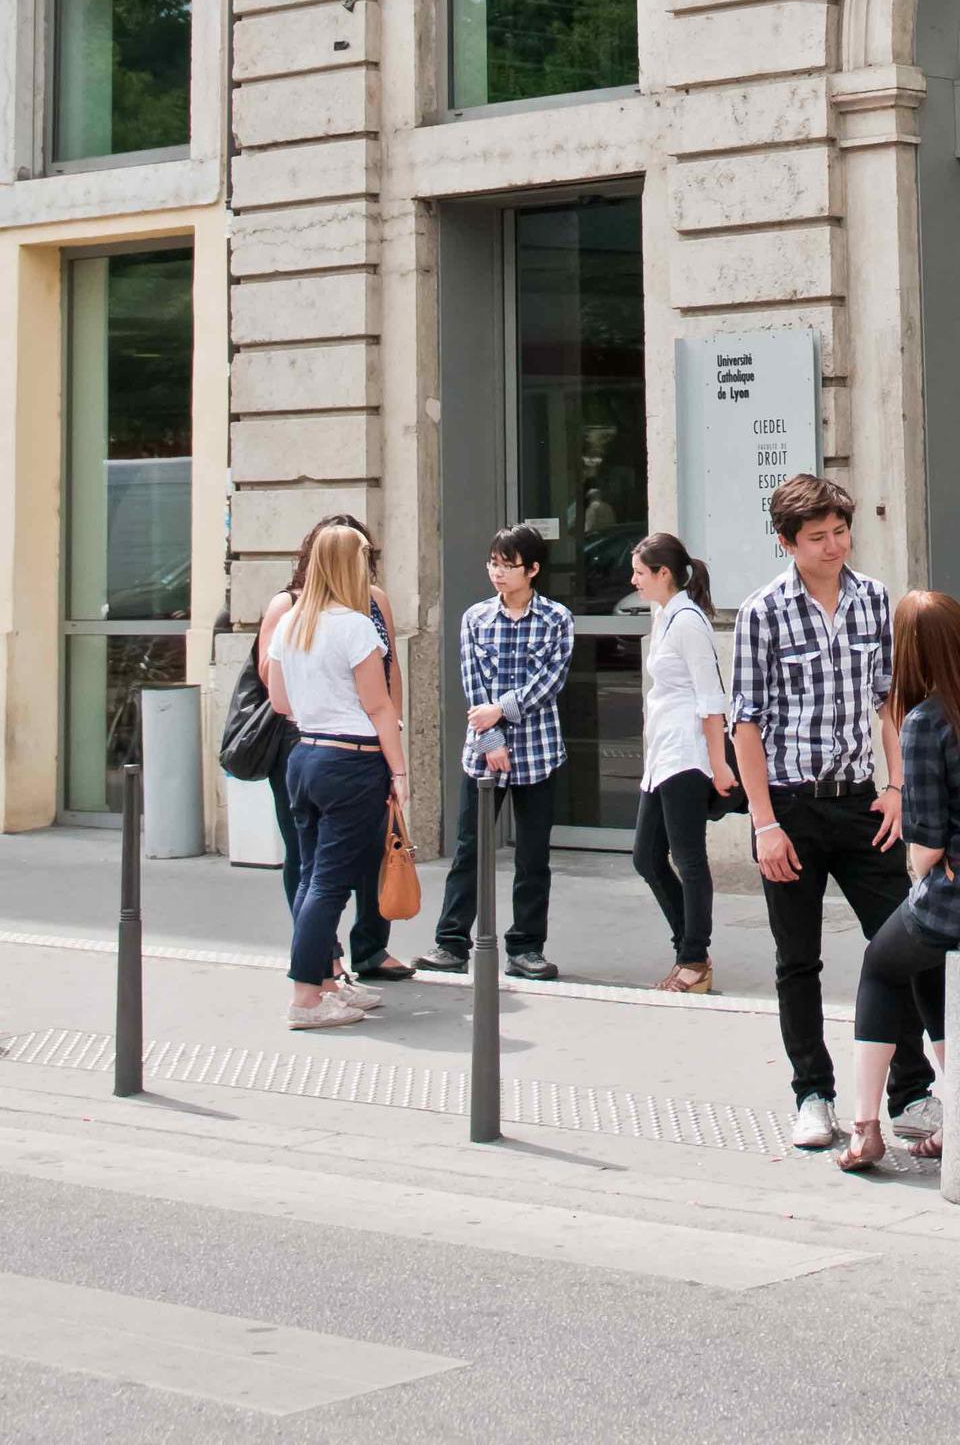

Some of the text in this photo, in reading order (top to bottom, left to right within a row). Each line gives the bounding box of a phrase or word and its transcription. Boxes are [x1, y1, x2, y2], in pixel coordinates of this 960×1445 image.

[717, 353, 752, 367] Université
[717, 369, 754, 384] Catholique
[717, 386, 749, 402] de Lyon
[753, 419, 787, 434] CIEDEL
[757, 451, 787, 466] DROIT
